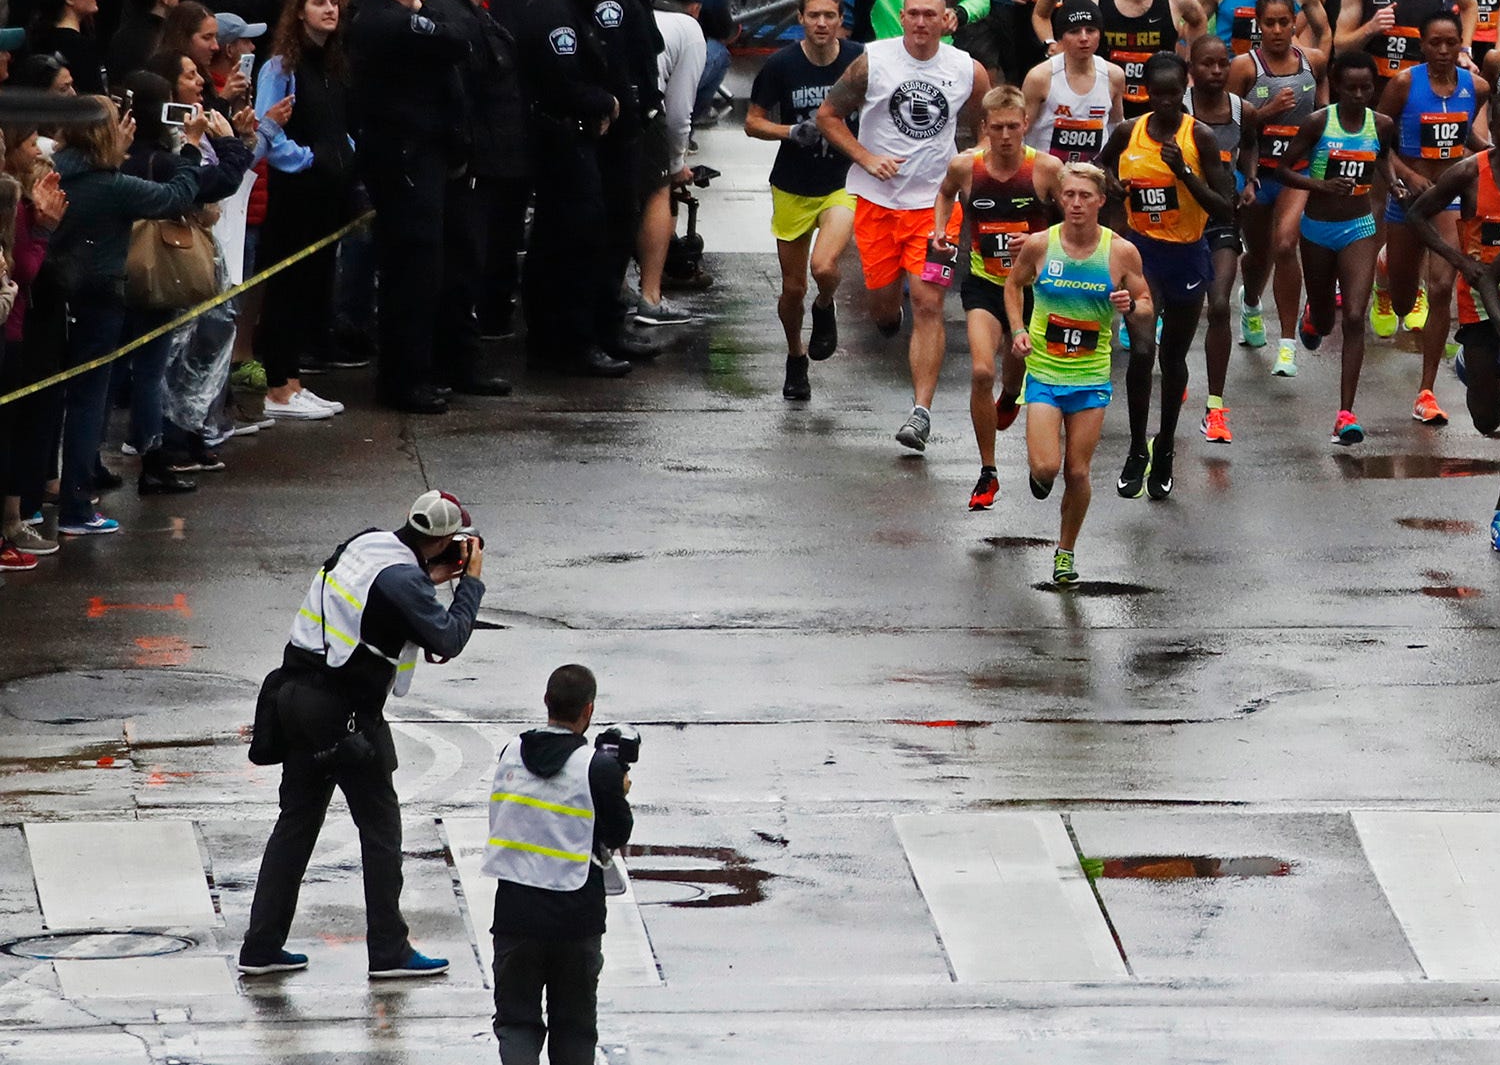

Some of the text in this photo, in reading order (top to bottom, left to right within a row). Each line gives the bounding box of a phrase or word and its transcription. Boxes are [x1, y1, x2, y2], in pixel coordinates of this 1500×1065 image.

[1387, 36, 1407, 53] 26
[1125, 62, 1145, 78] 60
[900, 81, 940, 97] GEORGE'S
[1058, 129, 1097, 148] 3904
[1433, 123, 1460, 140] 102
[1339, 160, 1365, 178] 101
[1138, 188, 1166, 205] 105
[1053, 279, 1107, 293] BROOKS
[1062, 328, 1082, 346] 16
